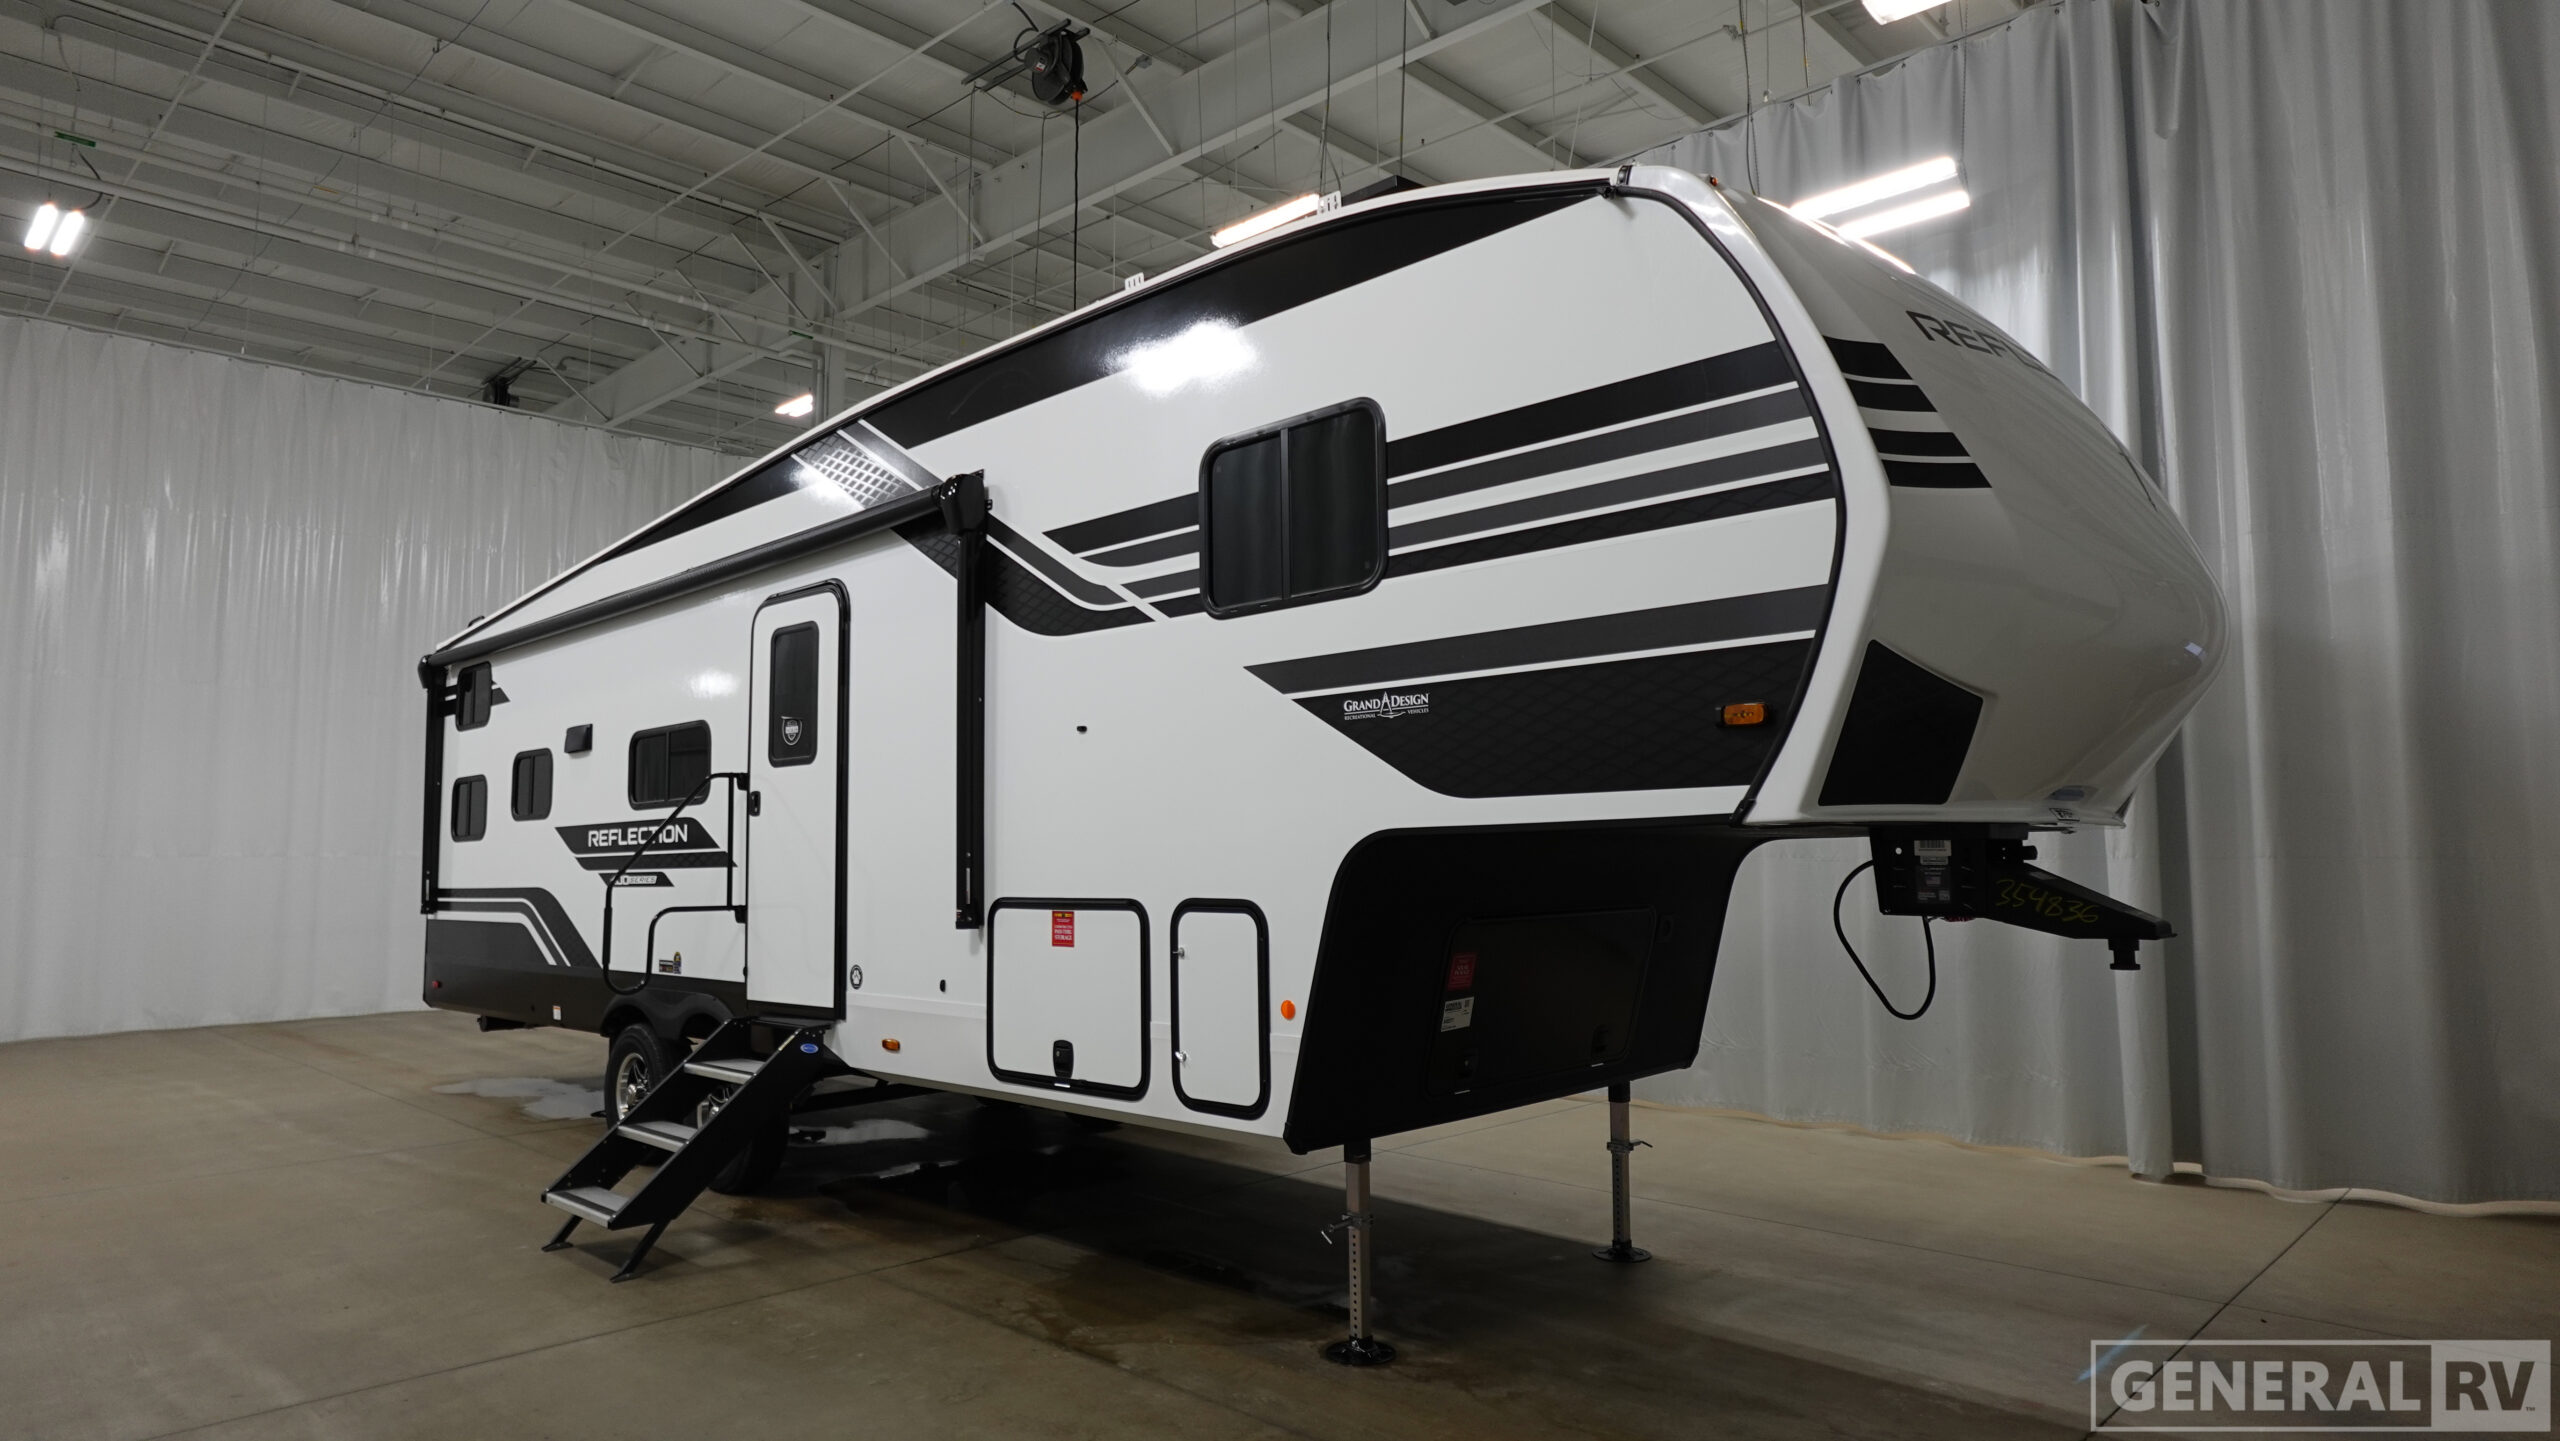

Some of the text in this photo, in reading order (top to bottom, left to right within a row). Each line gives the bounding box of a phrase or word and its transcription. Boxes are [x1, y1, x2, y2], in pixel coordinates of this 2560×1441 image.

[588, 824, 688, 847] REFLECTION
[630, 876, 656, 884] SERIES
[1995, 879, 2101, 924] 354836
